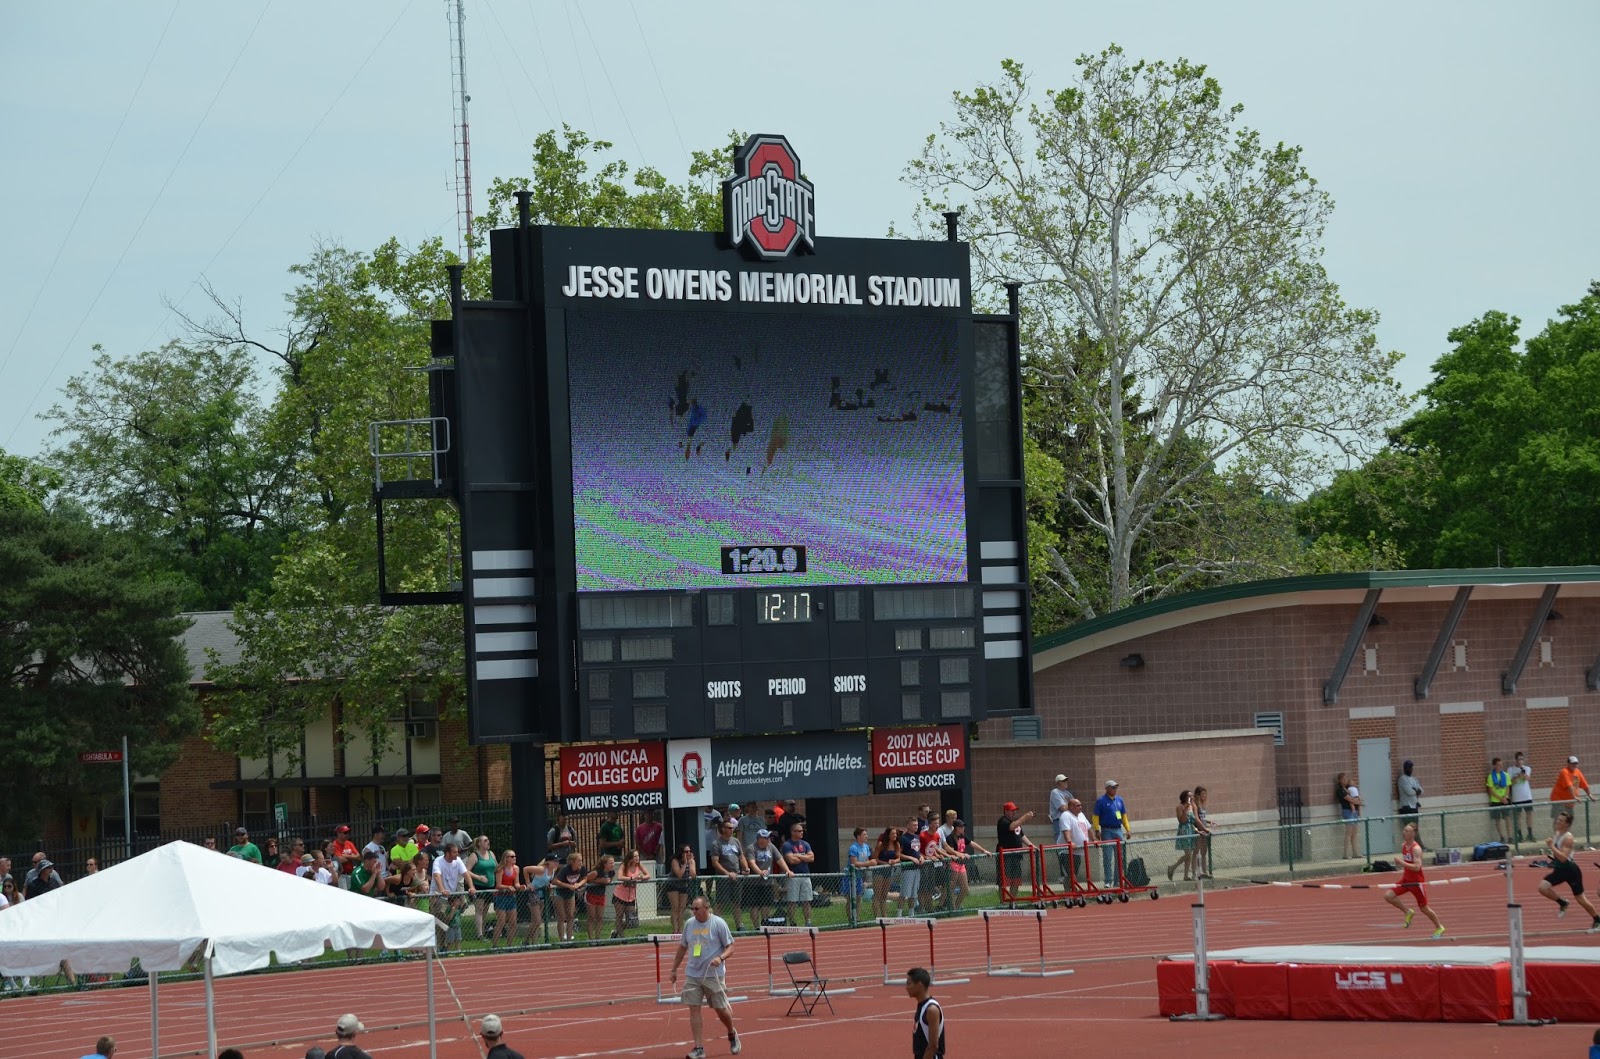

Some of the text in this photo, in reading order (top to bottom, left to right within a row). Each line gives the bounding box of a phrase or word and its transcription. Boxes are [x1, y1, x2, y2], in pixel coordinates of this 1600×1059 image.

[732, 169, 814, 249] OHIO STATE
[562, 265, 961, 308] JESSE OWENS MEMORIAL STADIUM
[728, 547, 799, 573] 1:20.9
[764, 593, 811, 621] 12:17
[707, 680, 742, 699] SHOTS
[768, 677, 807, 696] PERIOD
[833, 674, 867, 693] SHOTS
[887, 731, 951, 750] 2007 NCAA
[578, 748, 649, 768] 2010 NCAA
[716, 752, 863, 778] Athletes Helping Athletes
[879, 748, 960, 768] COLLEGE CUP
[568, 765, 660, 787] COLLEGE CUP
[727, 776, 783, 786] ohiostatebuckeyes.com
[885, 773, 956, 790] MEN'S SOCCER
[566, 792, 663, 811] WOMEN'S SOCCER
[1335, 971, 1386, 985] UCS
